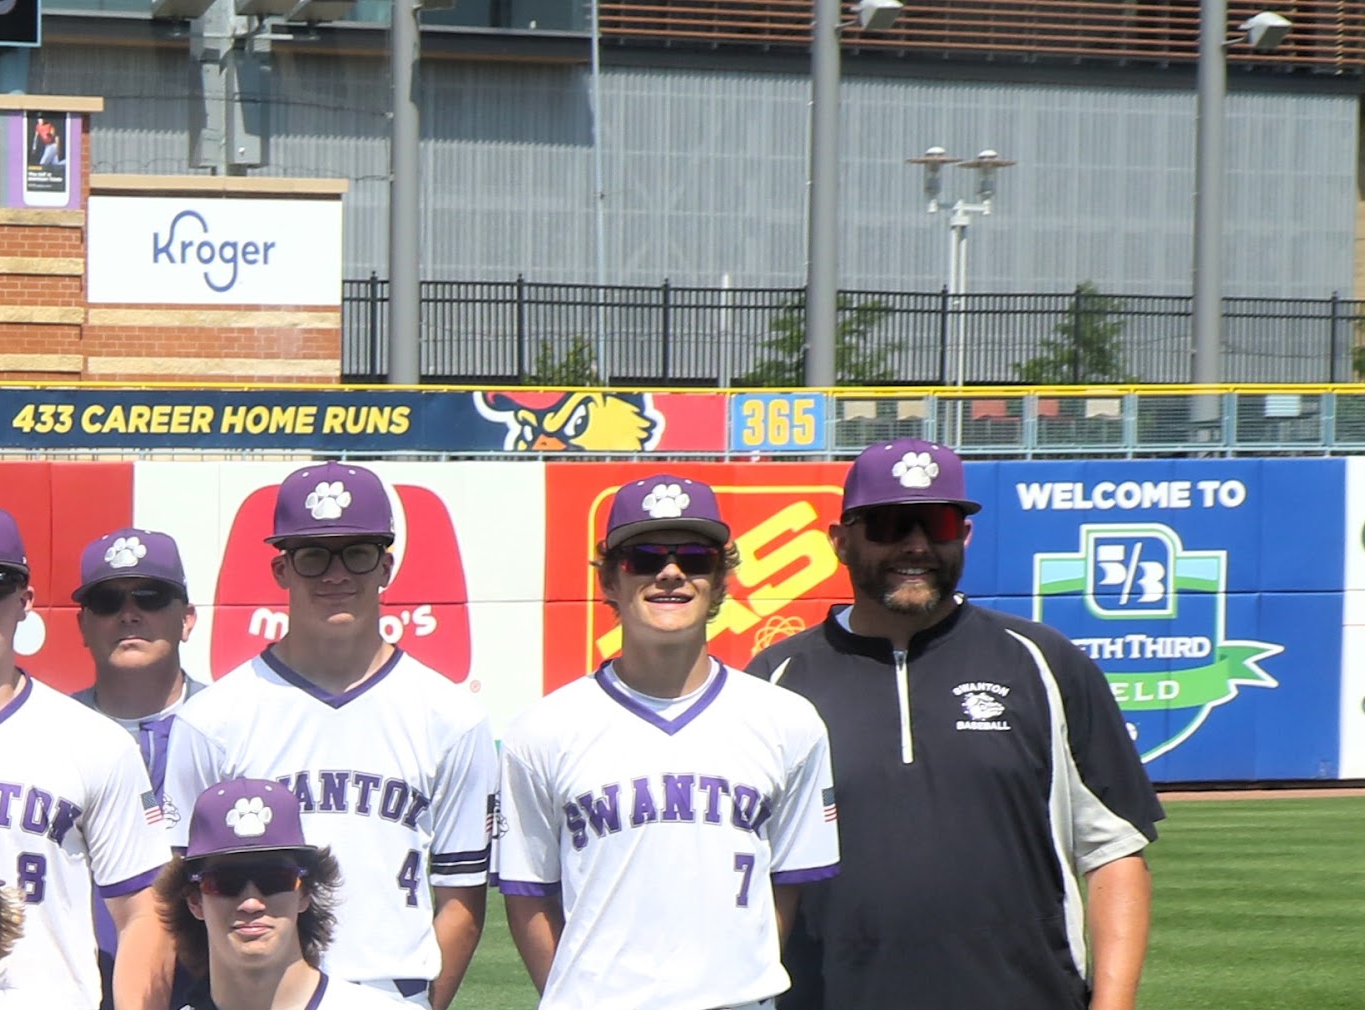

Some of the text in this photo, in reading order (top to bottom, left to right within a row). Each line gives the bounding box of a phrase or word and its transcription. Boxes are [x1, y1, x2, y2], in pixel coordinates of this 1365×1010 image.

[153, 210, 276, 293] Kroger
[12, 404, 411, 434] 433 CAREER HOME RUNS
[743, 399, 816, 446] 365
[1016, 480, 1247, 510] WELCOME TO
[1124, 634, 1212, 659] THIRD
[952, 682, 1010, 697] SWANTON
[1110, 680, 1180, 701] ELD
[956, 721, 1011, 730] BASEBALL
[275, 770, 432, 827] ANTON
[17, 852, 47, 904] 8
[396, 849, 422, 908] 4
[733, 852, 756, 908] 7
